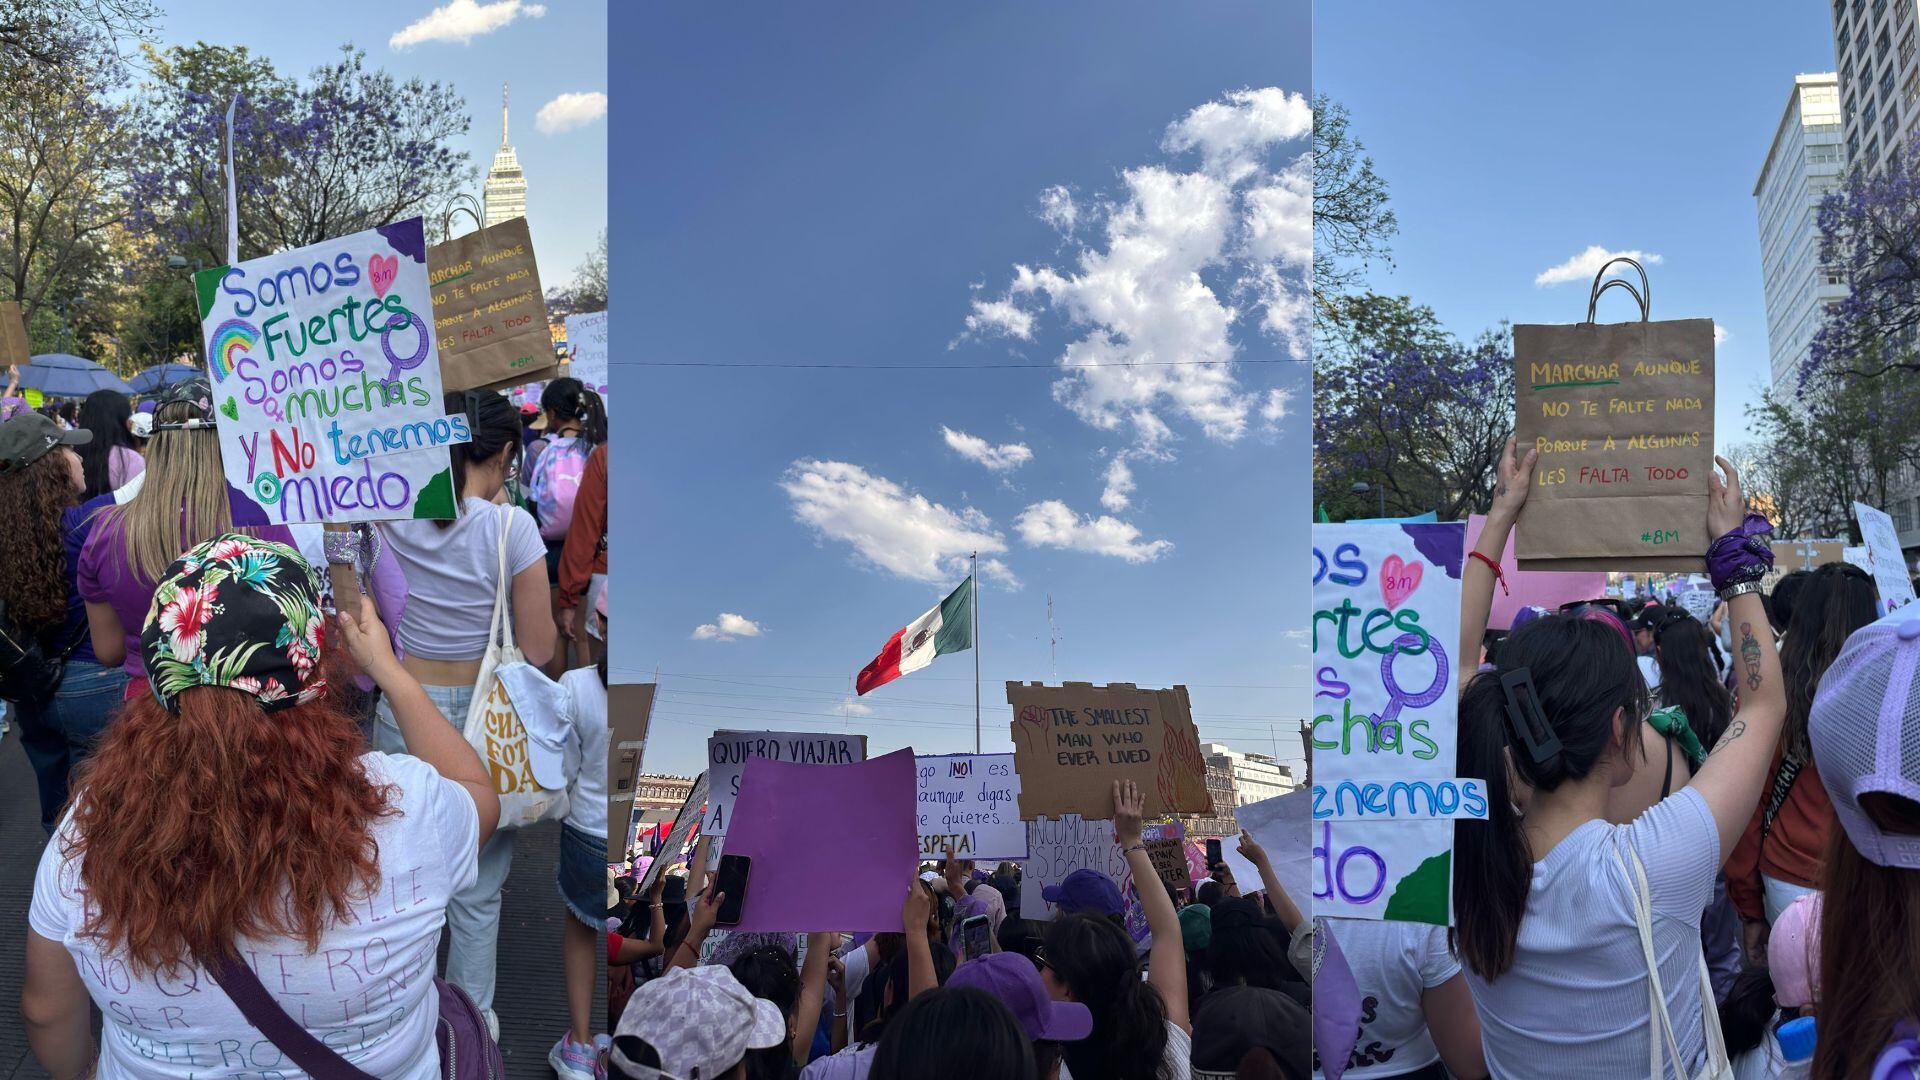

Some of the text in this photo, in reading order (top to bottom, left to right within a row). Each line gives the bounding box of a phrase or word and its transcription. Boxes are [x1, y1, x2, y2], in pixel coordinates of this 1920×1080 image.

[430, 244, 524, 284] ARCHAR AUNQUE
[222, 252, 360, 317] Somos
[452, 288, 464, 299] TE
[470, 278, 500, 294] FALTE
[506, 269, 530, 283] NADA
[473, 308, 481, 319] A
[262, 294, 412, 361] Fuertes
[437, 315, 531, 350] LES FALTA TODO
[237, 350, 364, 404] Somos
[1530, 359, 1702, 384] MARCHAR AUNQUE
[285, 371, 430, 423] muchas
[1542, 398, 1702, 417] NO TE FALTE NADA
[328, 417, 470, 465] tenemos
[1536, 431, 1700, 453] PORQUE A ALGUNAS
[1539, 466, 1689, 486] LES FALTA TODO
[1640, 530, 1679, 544] #8M
[1047, 706, 1151, 727] THE SMALLEST
[789, 740, 853, 764] VIAJAR
[1057, 731, 1143, 748] MAN WHO
[988, 764, 1009, 776] es
[1057, 749, 1151, 766] EVER LIVED
[919, 782, 1012, 813] aunque digas
[918, 831, 976, 856] ESPETA!
[109, 1001, 190, 1031] SER
